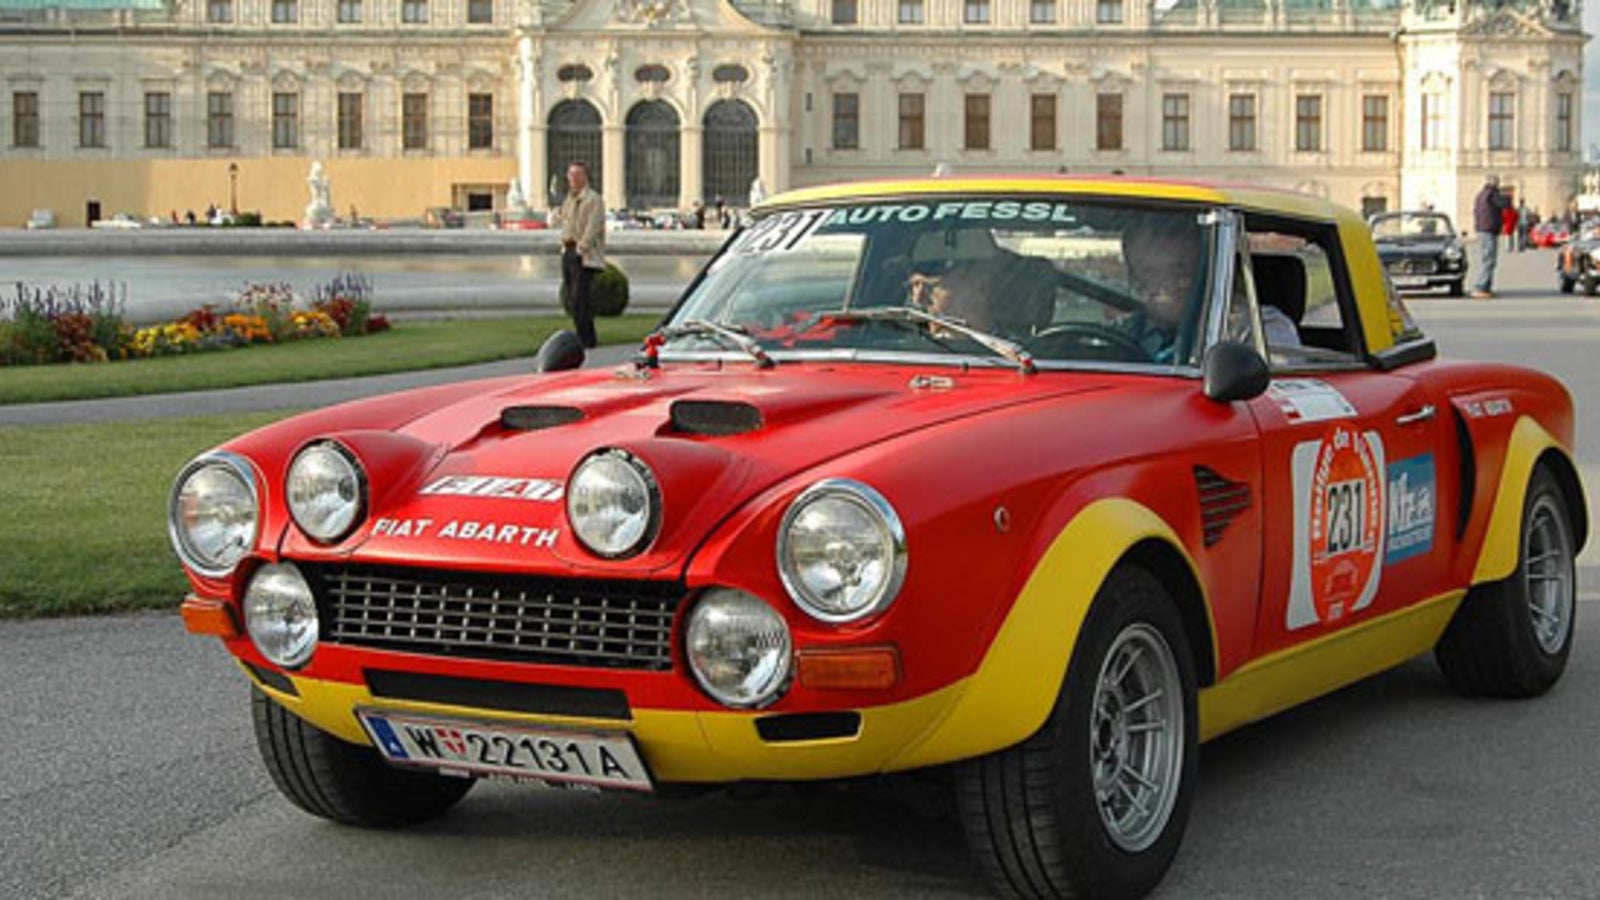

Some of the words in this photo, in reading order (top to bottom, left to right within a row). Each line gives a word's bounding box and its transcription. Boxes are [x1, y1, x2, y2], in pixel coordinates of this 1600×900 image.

[825, 204, 929, 226] AUTO
[933, 201, 1077, 222] FESSL
[740, 209, 824, 253] 231
[372, 518, 433, 537] FIAT
[438, 520, 559, 547] ABARTH
[1328, 481, 1362, 552] 231
[406, 726, 442, 758] W
